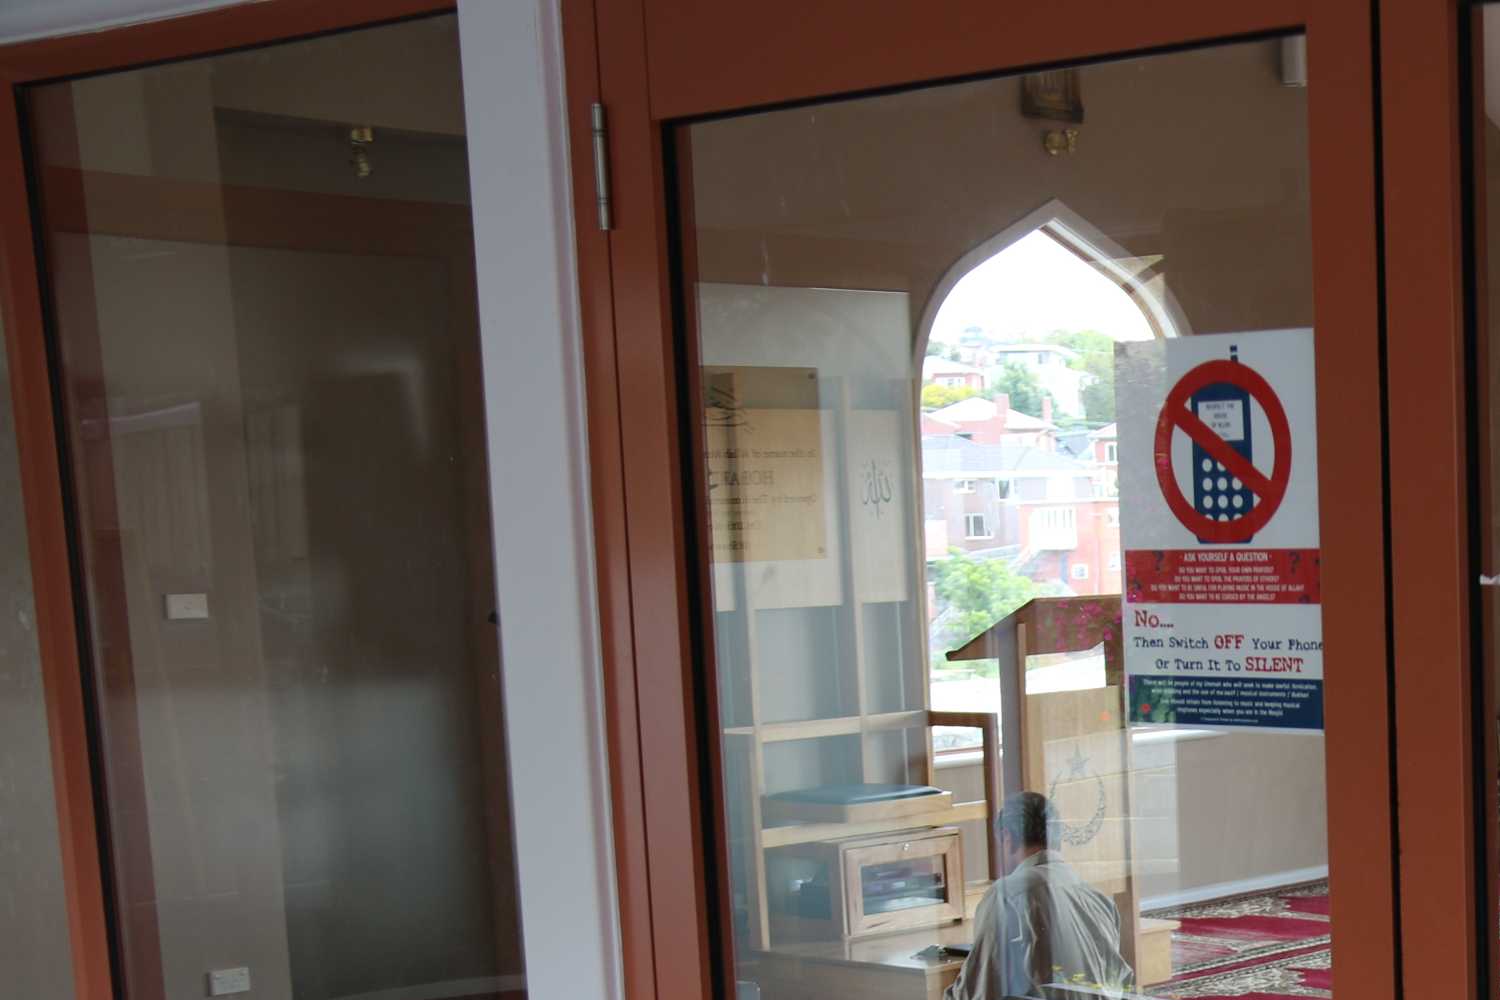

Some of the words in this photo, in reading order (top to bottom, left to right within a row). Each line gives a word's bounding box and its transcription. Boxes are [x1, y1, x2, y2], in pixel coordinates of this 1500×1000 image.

[1134, 637, 1164, 649] Then
[1169, 637, 1209, 649] Switch
[1214, 634, 1244, 649] OFF
[1252, 638, 1282, 651] Your
[1155, 659, 1169, 670] Or
[1174, 659, 1203, 670] Turn
[1208, 660, 1221, 671] It
[1225, 661, 1241, 672] To
[1245, 656, 1304, 673] SILENT
